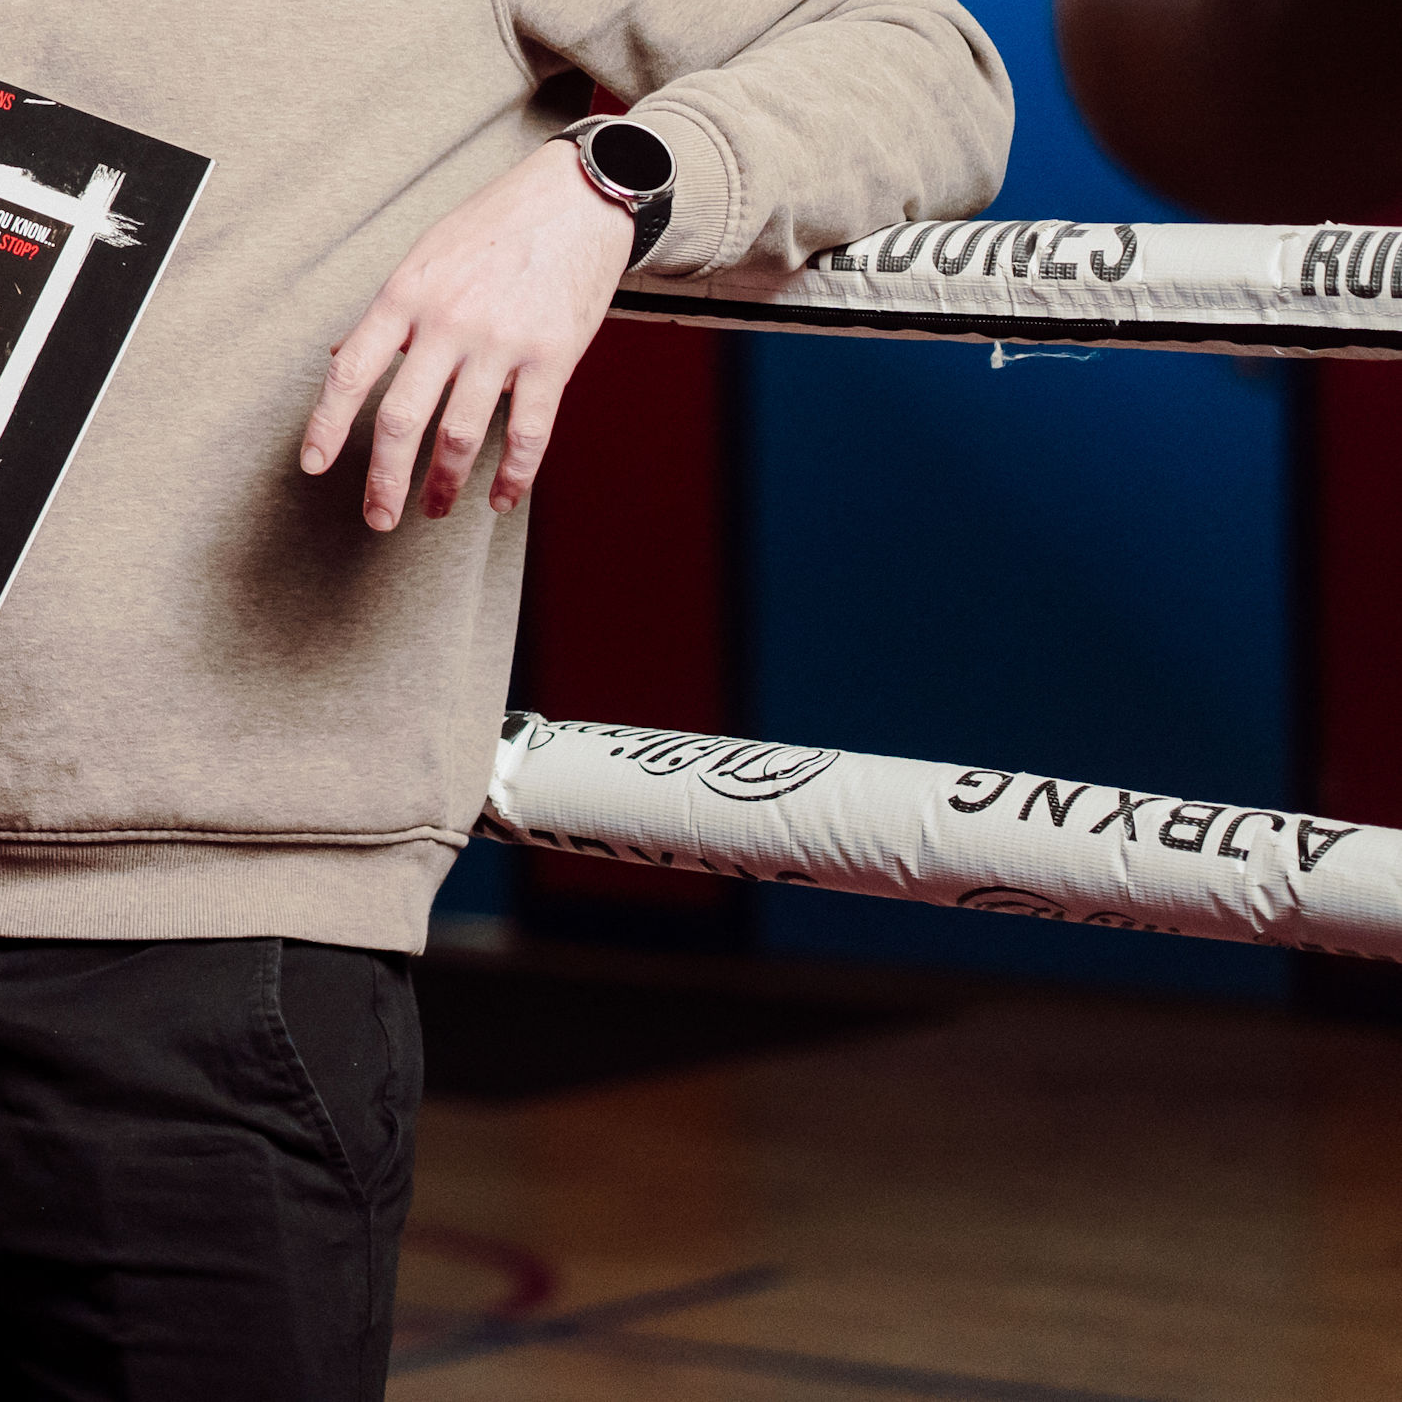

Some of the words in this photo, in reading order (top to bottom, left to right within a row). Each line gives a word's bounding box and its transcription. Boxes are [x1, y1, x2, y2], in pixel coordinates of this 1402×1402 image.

[10, 215, 56, 248] KNOW...
[1300, 229, 1402, 300] RU
[947, 770, 1363, 873] AJBXNG
